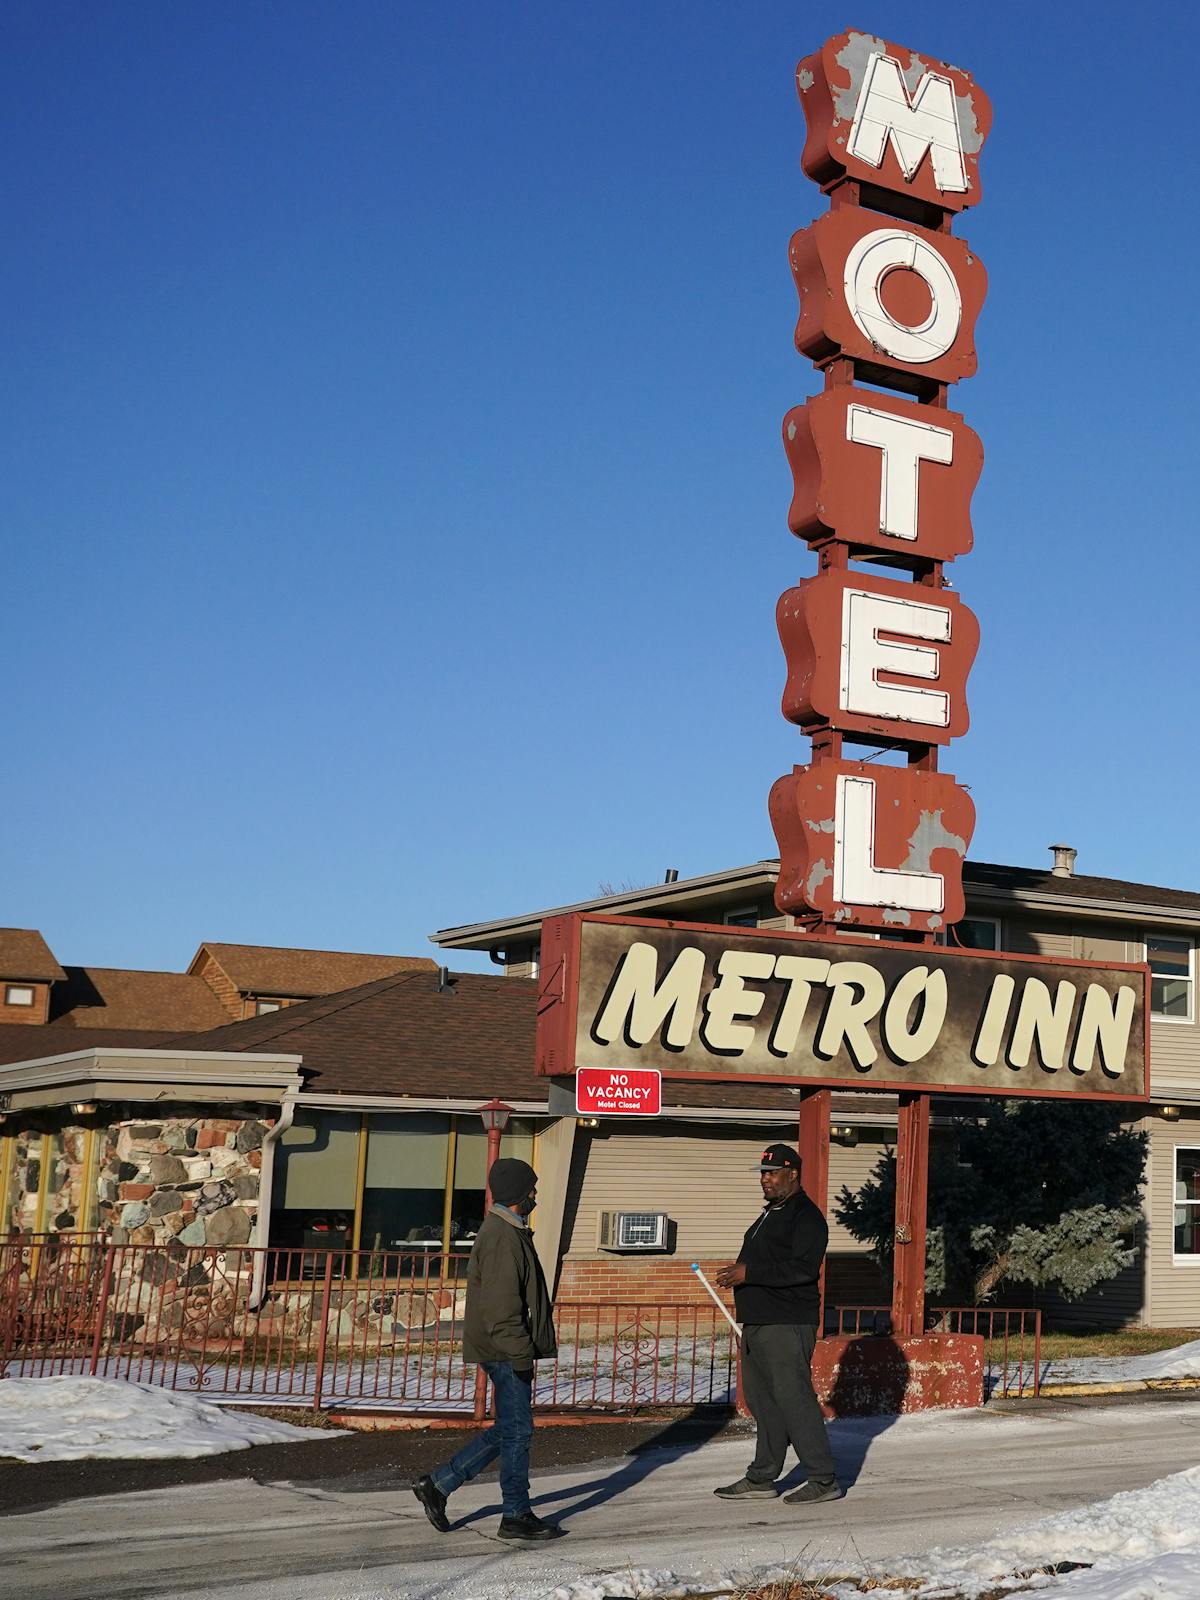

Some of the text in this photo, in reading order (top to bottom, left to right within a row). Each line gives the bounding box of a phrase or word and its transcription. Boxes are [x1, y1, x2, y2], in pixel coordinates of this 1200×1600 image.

[833, 51, 968, 913] MOTEL
[591, 942, 1136, 1079] METRO INN
[610, 1074, 628, 1086] NO
[586, 1086, 651, 1099] VACANCY
[618, 1101, 640, 1109] Closed
